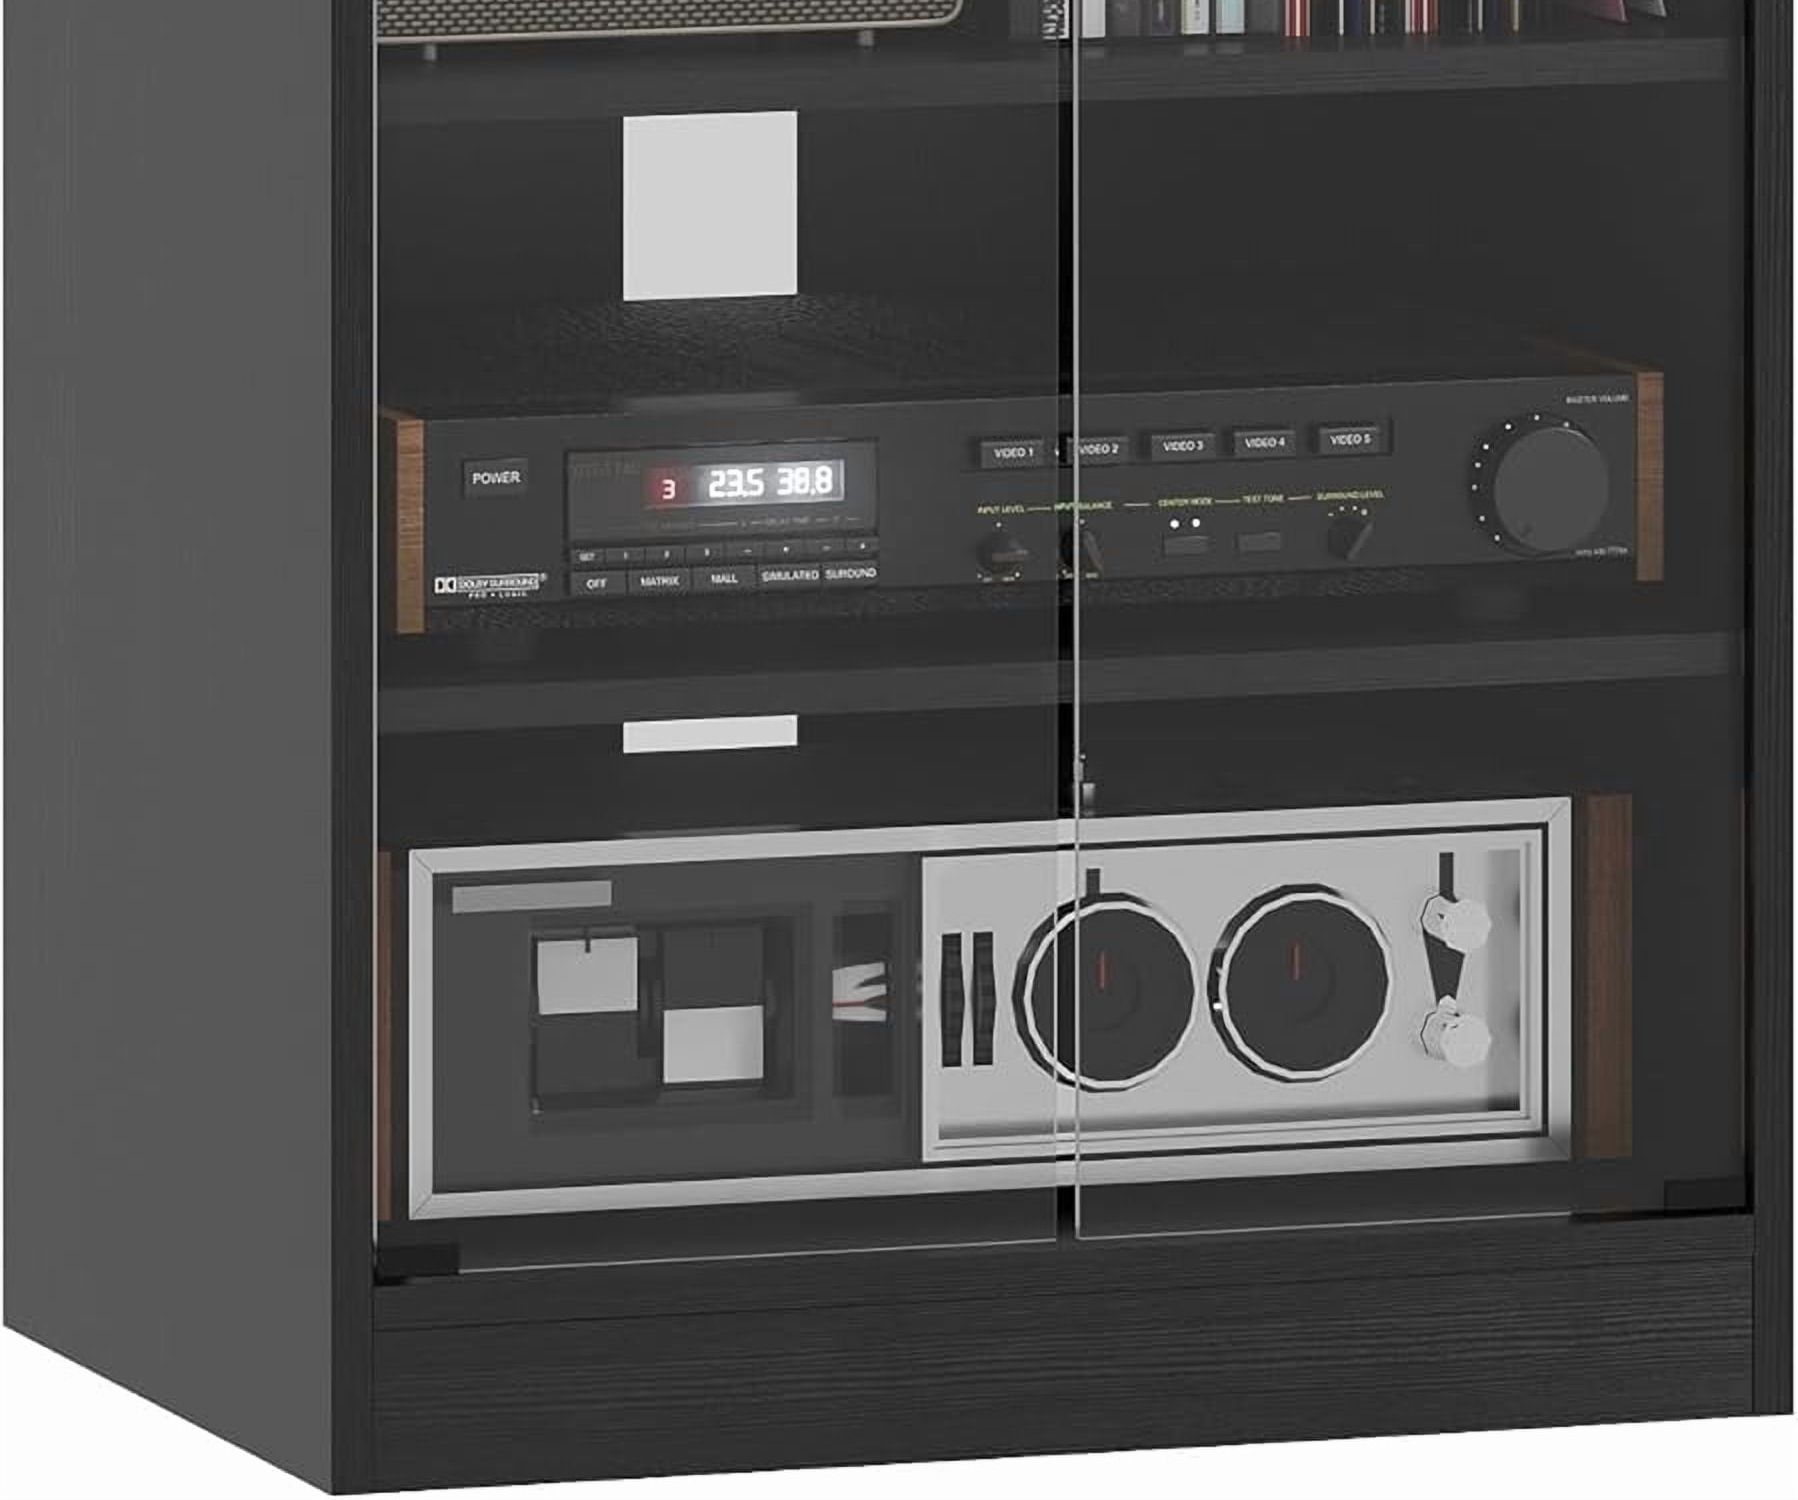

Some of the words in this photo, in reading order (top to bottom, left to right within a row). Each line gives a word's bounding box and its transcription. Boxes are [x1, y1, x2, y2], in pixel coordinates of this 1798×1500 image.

[1163, 440, 1196, 452] VIDEO
[1197, 439, 1204, 451] 3
[1244, 437, 1278, 449] VIDEO
[1278, 436, 1286, 448] 4
[1329, 433, 1363, 446] VIDEO
[1364, 432, 1372, 444] 5
[993, 447, 1026, 459] VIDEO
[1029, 446, 1034, 457] 1
[1111, 442, 1120, 454] 2
[472, 470, 522, 485] POWER
[661, 479, 676, 500] 3
[1361, 490, 1385, 500] LEVEL
[1001, 504, 1025, 514] LEVEL
[761, 568, 820, 582] SIMULATED
[825, 567, 878, 580] SURROUND
[586, 578, 607, 590] OFF
[640, 574, 681, 587] MATRIX
